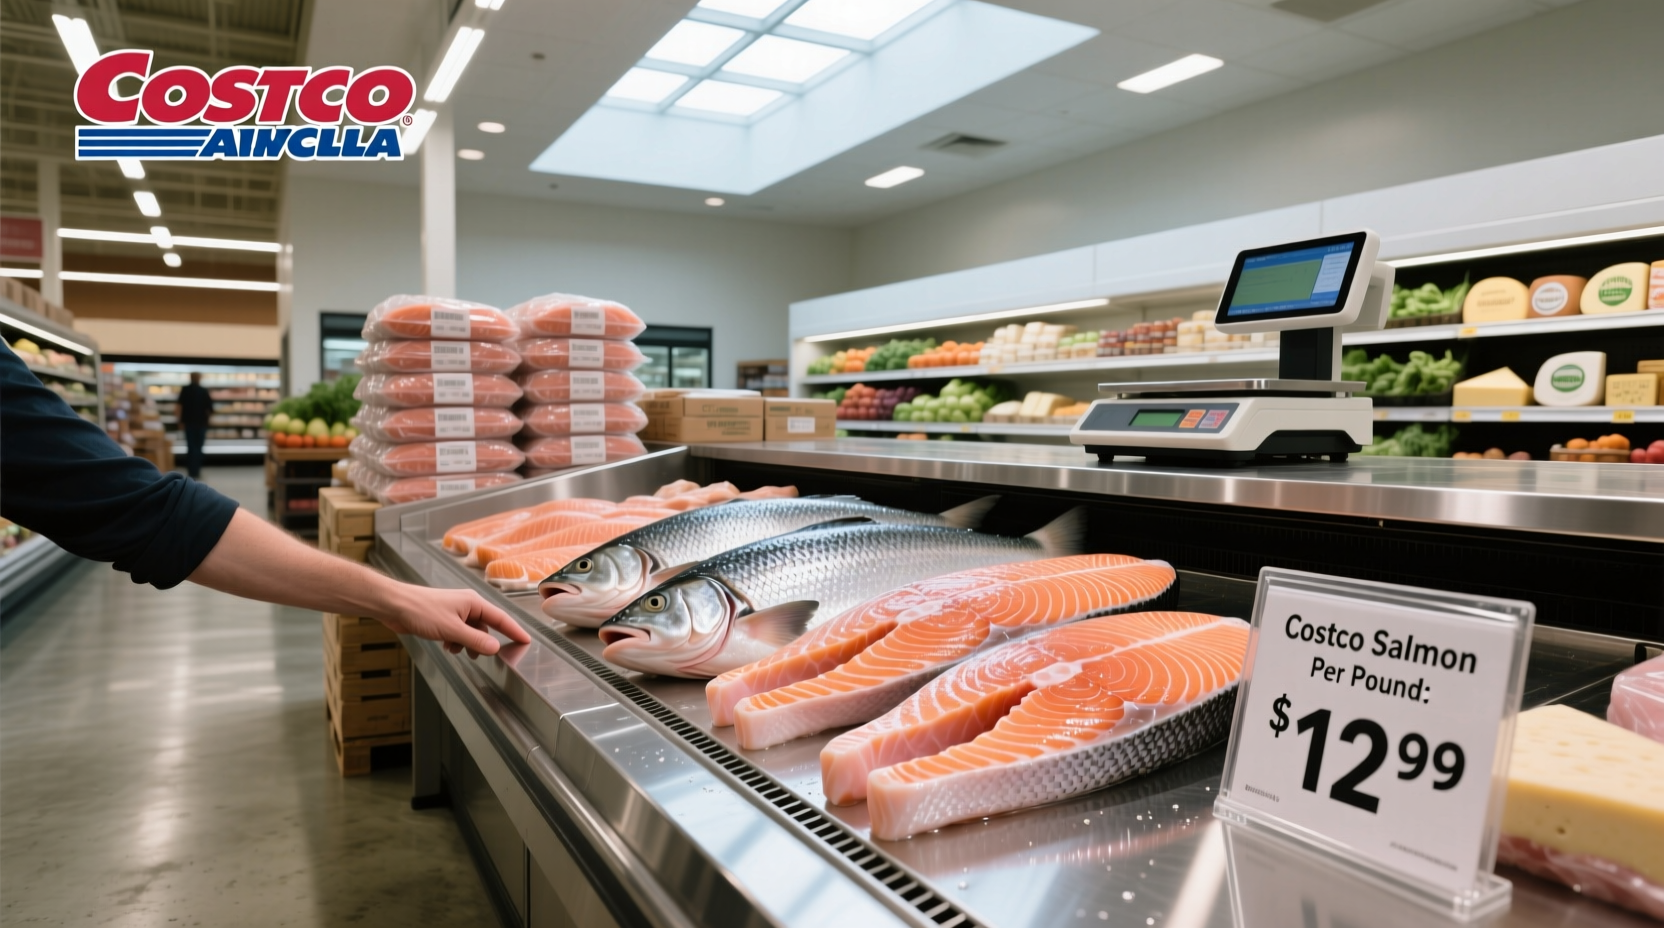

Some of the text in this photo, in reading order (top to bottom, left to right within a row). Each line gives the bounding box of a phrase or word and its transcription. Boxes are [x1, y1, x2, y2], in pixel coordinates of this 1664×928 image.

[1285, 613, 1477, 674] Costco Salmon
[1310, 656, 1432, 705] Per Pound:
